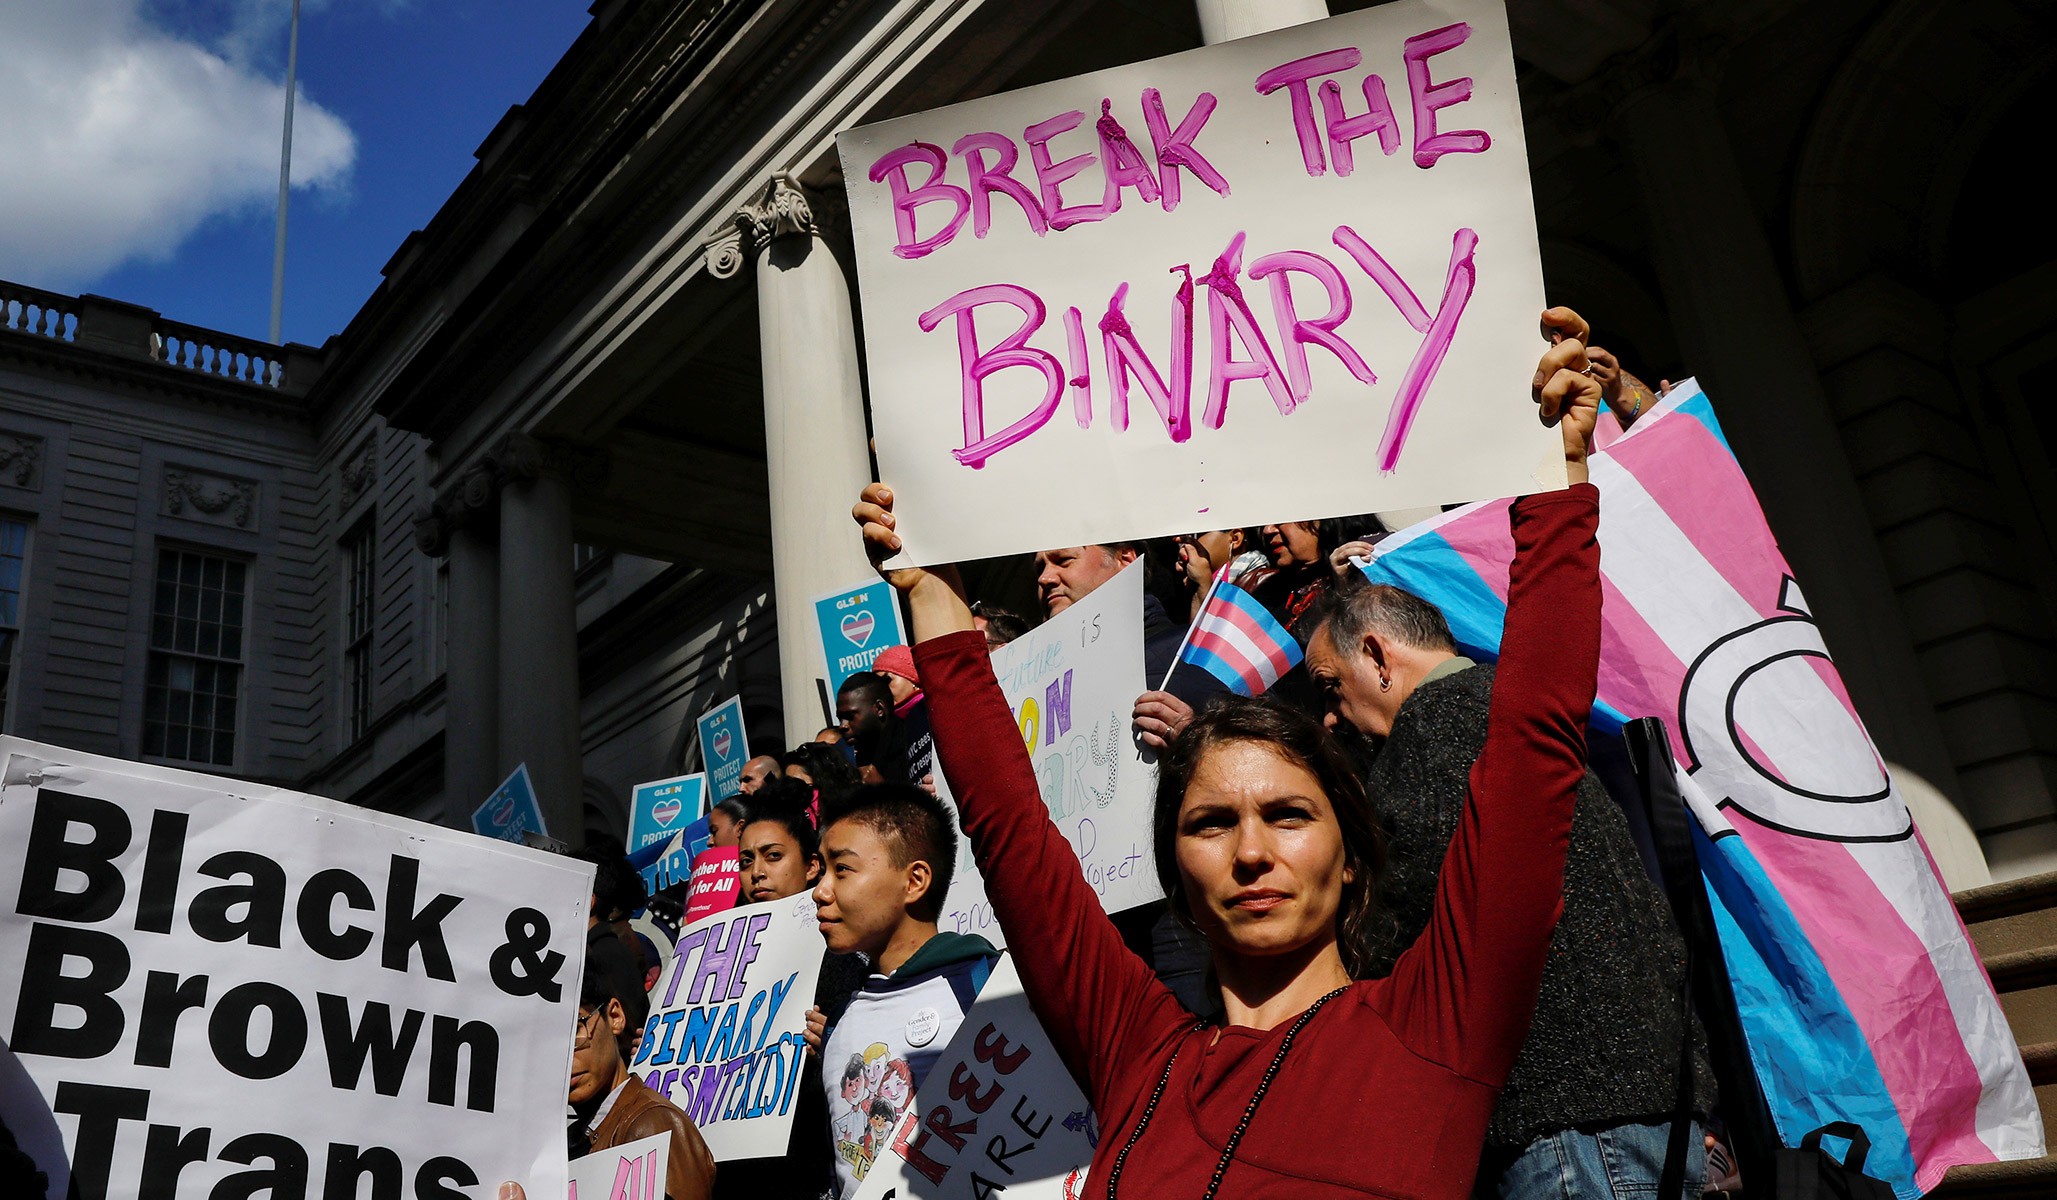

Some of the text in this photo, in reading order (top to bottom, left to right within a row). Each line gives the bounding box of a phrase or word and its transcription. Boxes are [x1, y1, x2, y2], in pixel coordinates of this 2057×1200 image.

[869, 22, 1491, 259] BREAK THE
[918, 225, 1479, 477] BINARY
[836, 593, 868, 609] GLSEN
[1082, 613, 1101, 648] is
[917, 732, 931, 750] sees
[1010, 668, 1073, 758] ON
[654, 786, 682, 797] GLSEN
[713, 758, 740, 783] PROTECT
[719, 775, 741, 797] TRANS
[15, 788, 567, 1003] Black &
[696, 881, 712, 895] for
[713, 878, 735, 892] All
[1078, 818, 1141, 896] Project
[661, 913, 772, 1009] THE
[9, 922, 499, 1113] Brown
[633, 971, 799, 1066] BINARY
[723, 1031, 807, 1120] EXIST
[890, 1022, 1032, 1187] FREE
